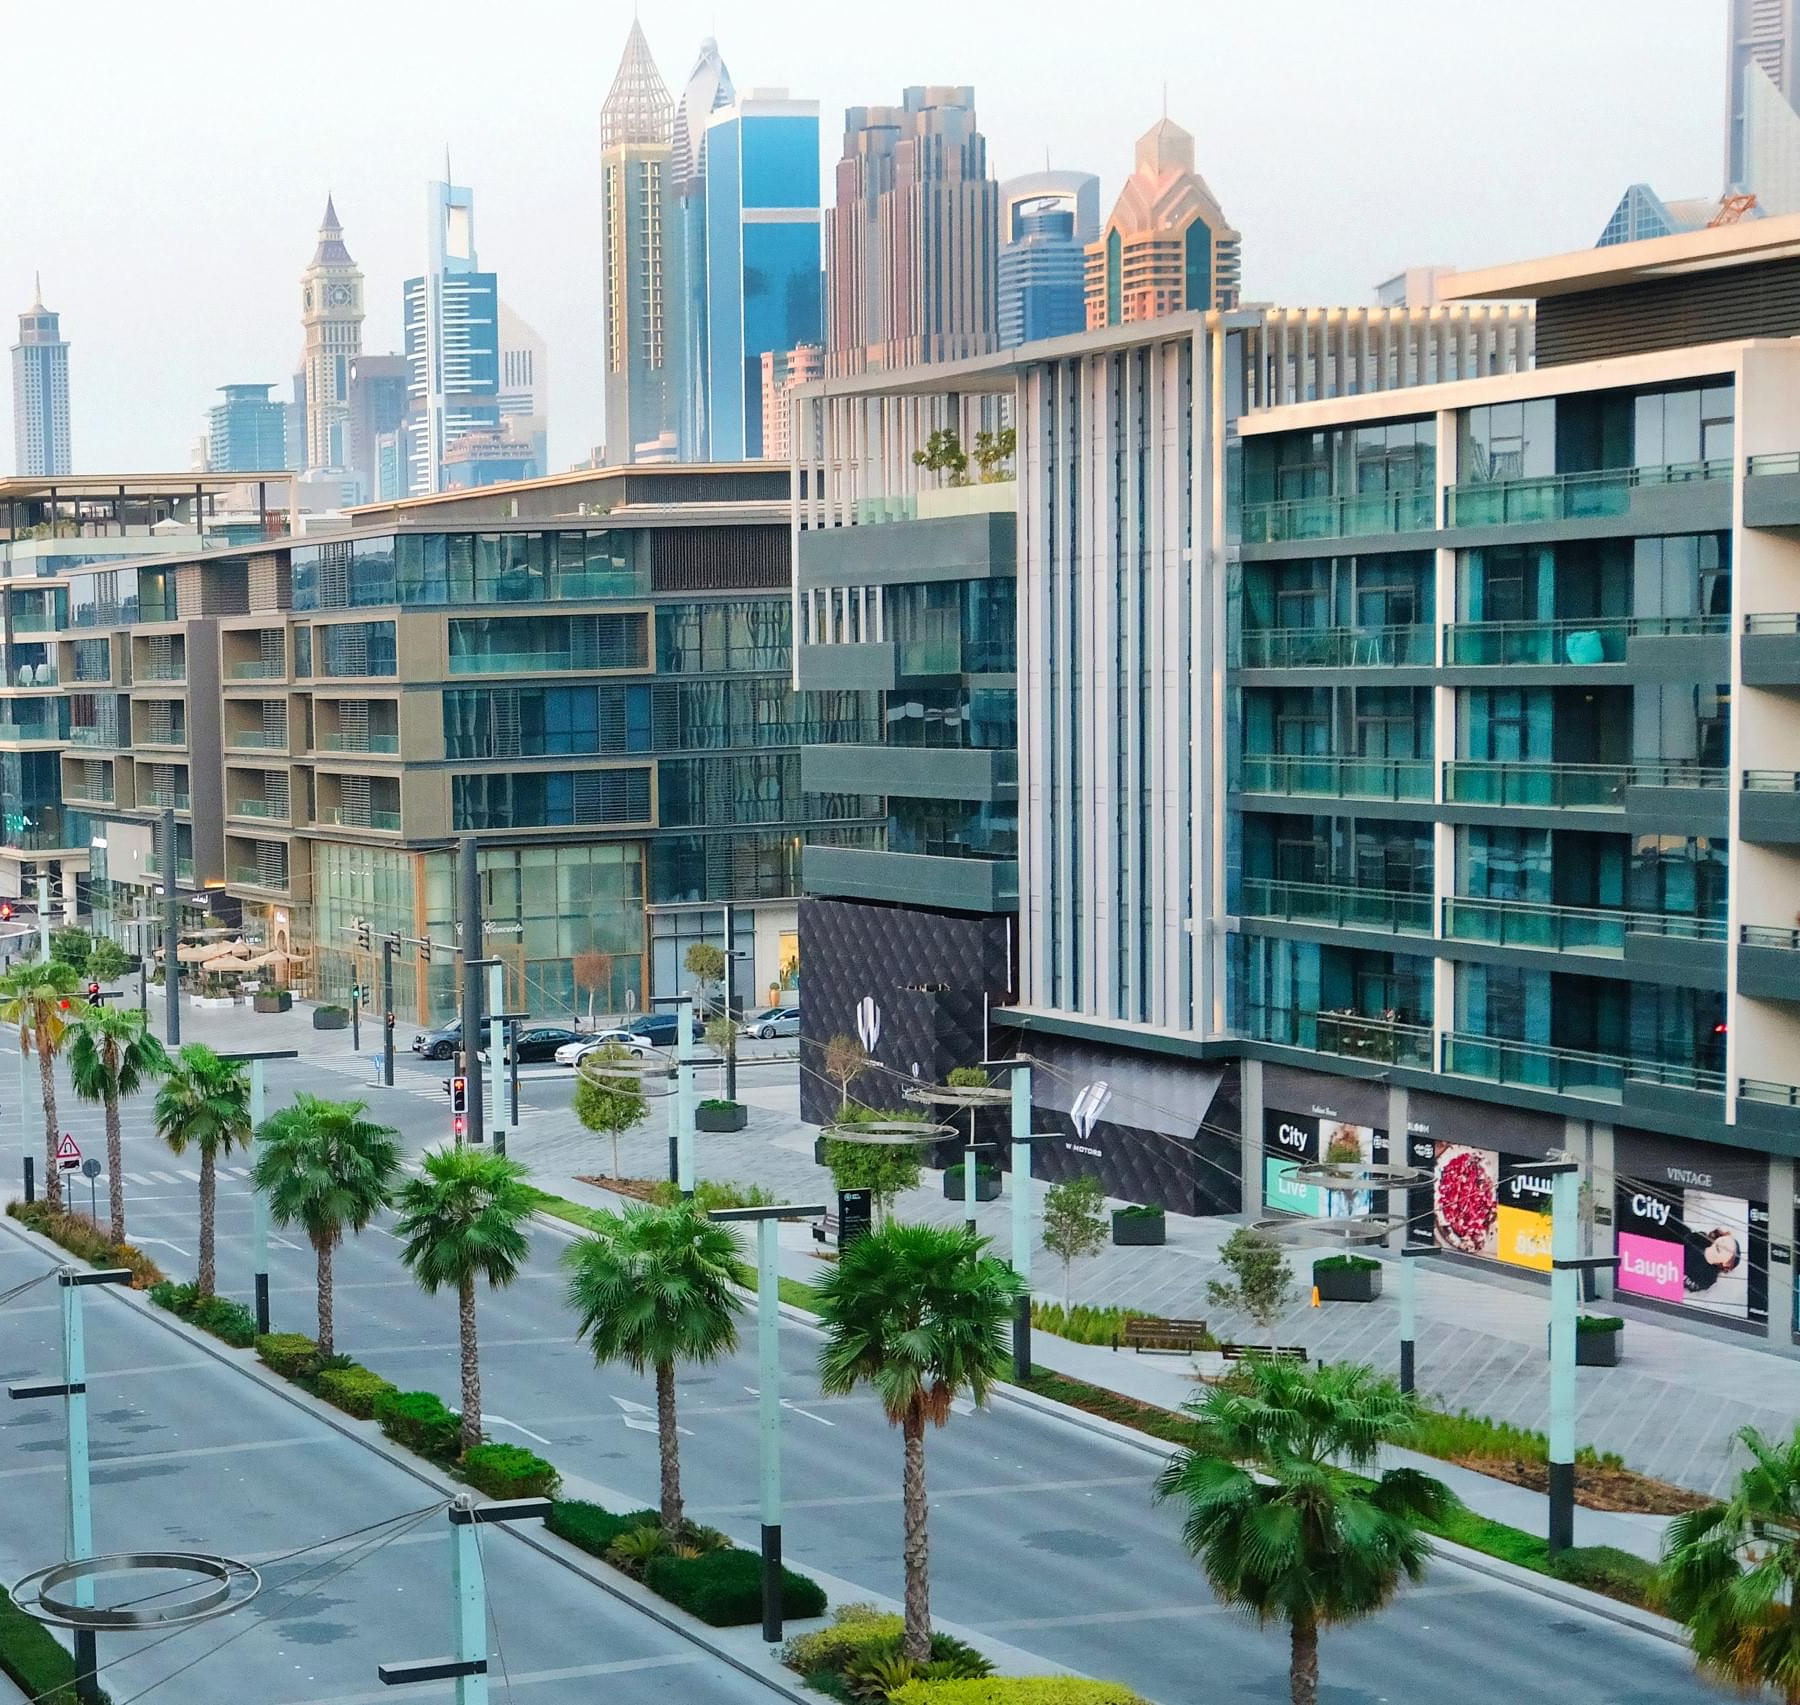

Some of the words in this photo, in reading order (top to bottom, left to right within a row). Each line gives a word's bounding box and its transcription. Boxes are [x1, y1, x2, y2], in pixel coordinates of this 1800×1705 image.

[483, 921, 523, 935] Concerto
[1279, 1123, 1308, 1151] City
[1073, 1144, 1102, 1157] MOTORS
[1667, 1167, 1713, 1187] VINTAGE
[1278, 1178, 1307, 1199] Live
[1632, 1193, 1671, 1226] City
[1623, 1251, 1679, 1285] Laugh
